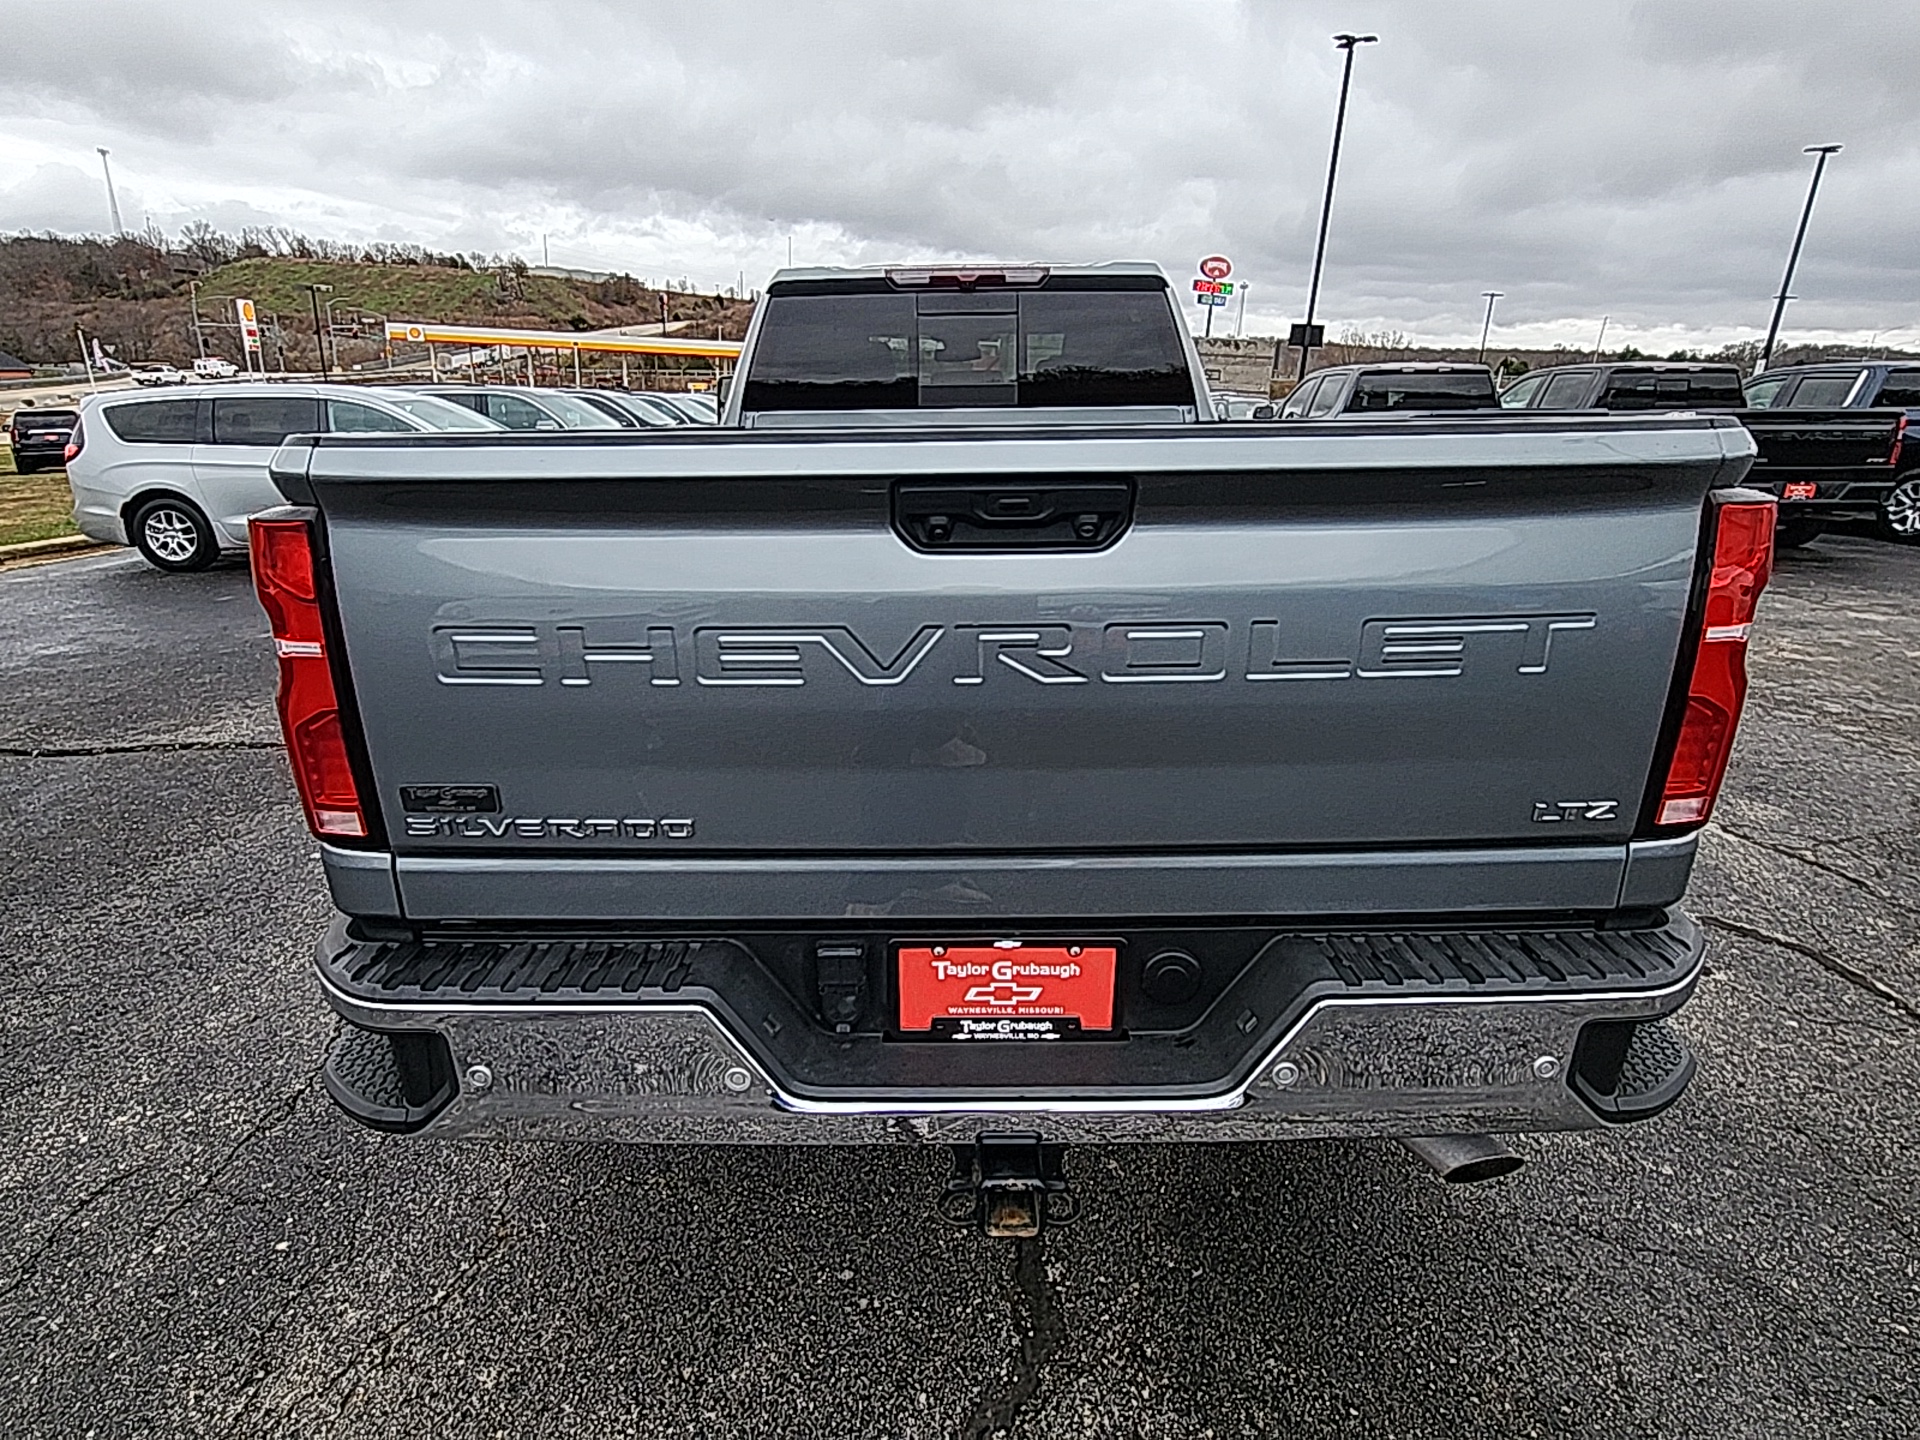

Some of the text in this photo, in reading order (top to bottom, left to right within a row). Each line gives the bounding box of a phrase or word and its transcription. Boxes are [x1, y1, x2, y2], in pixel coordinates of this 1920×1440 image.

[432, 612, 1597, 686] CHEVROLET
[1533, 801, 1618, 821] LTZ
[405, 816, 696, 838] SILVERADO
[931, 960, 1081, 980] Taylor Grubaugh
[947, 1006, 1064, 1015] WAYNESVILLE, MISSOURI
[960, 1020, 1053, 1033] Taylor Grubaugh
